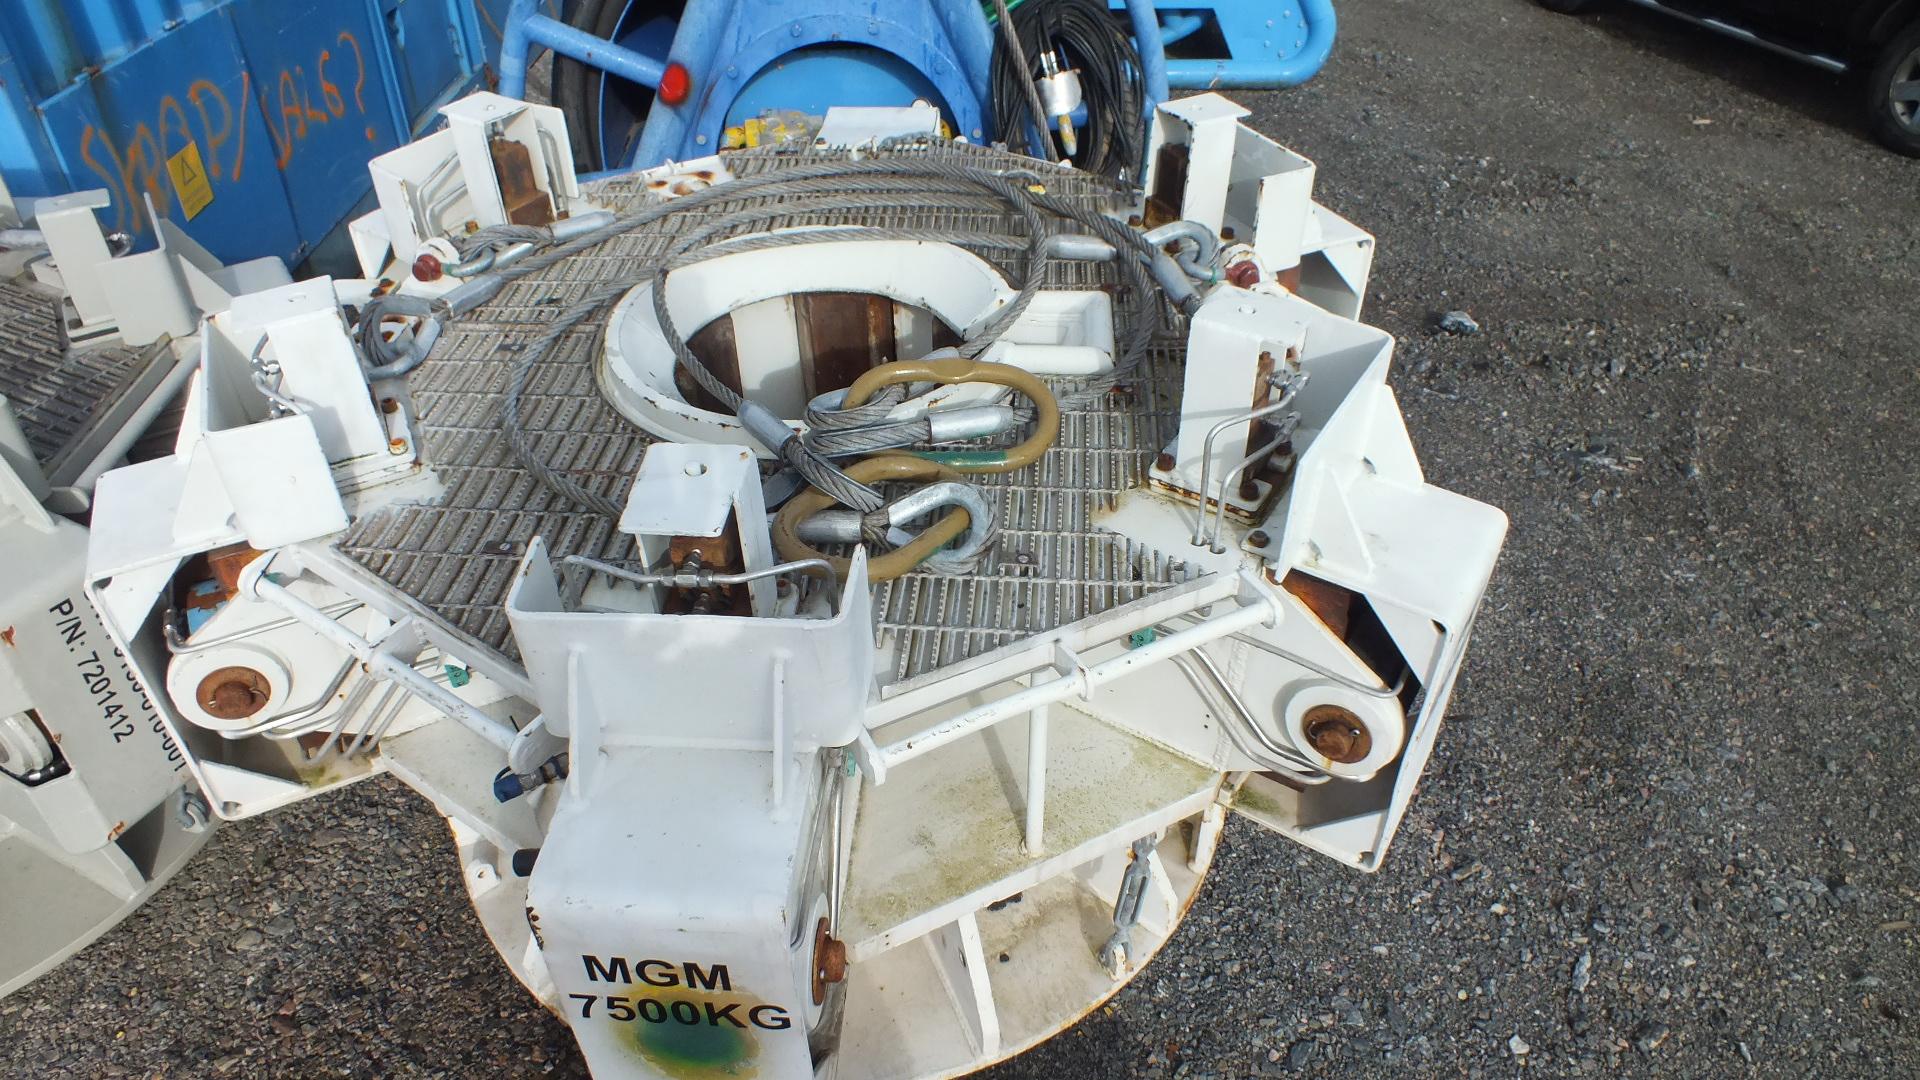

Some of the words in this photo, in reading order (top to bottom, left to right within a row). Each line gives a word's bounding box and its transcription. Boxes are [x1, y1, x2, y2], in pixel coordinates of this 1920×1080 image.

[49, 597, 87, 653] P/N:
[77, 650, 135, 743] 7201412
[581, 954, 732, 991] MGM
[568, 993, 791, 1030] 7500KG
